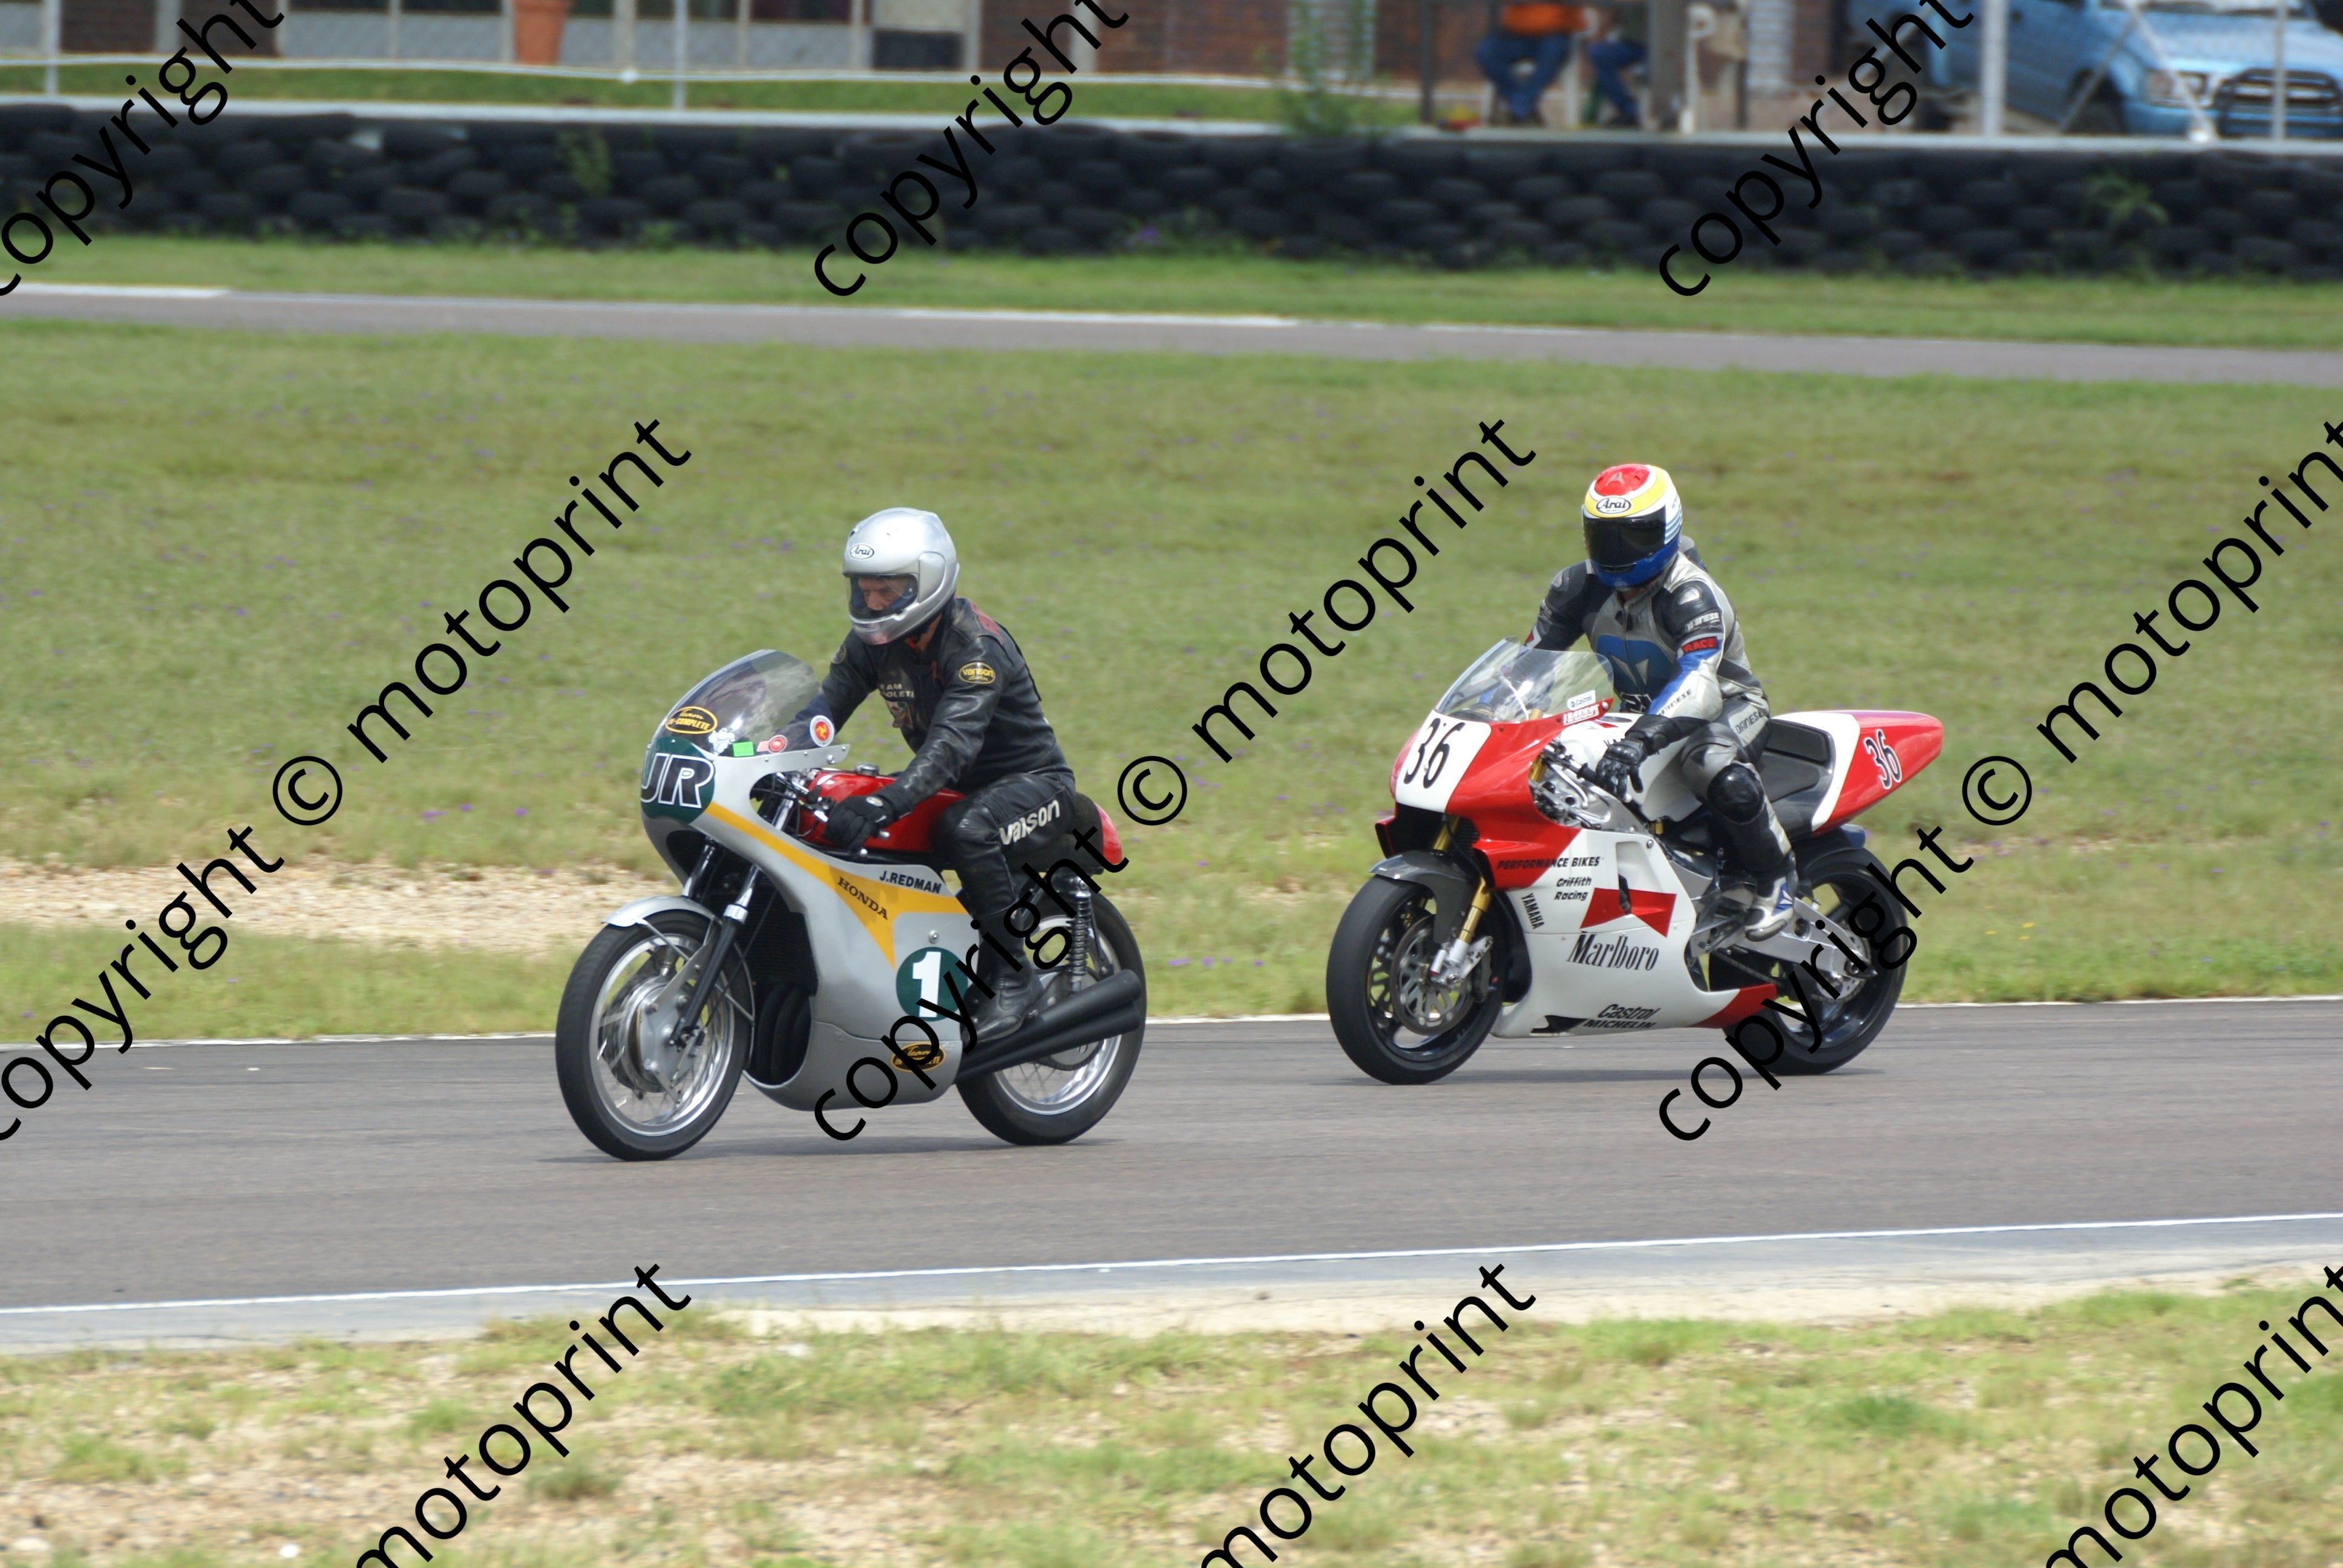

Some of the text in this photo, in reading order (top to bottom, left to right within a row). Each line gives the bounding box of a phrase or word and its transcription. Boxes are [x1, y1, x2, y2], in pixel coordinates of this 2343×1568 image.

[1599, 497, 1627, 509] Arai
[1682, 637, 1718, 653] RACE
[962, 667, 994, 678] vanson
[1403, 717, 1466, 789] 36
[1863, 728, 1902, 790] 36
[640, 753, 715, 809] JR
[1497, 856, 1601, 870] PERFORMANCE BIKES
[879, 871, 942, 894] J.REDMAN
[1556, 876, 1592, 887] Griffith
[837, 877, 888, 920] HONDA
[1554, 890, 1589, 901] Racing
[1521, 892, 1545, 930] YAMAHA
[1566, 931, 1659, 971] Marlboro
[912, 951, 942, 1018] 1
[1598, 1003, 1662, 1020] Castrol
[1583, 1019, 1657, 1029] MICHELIN
